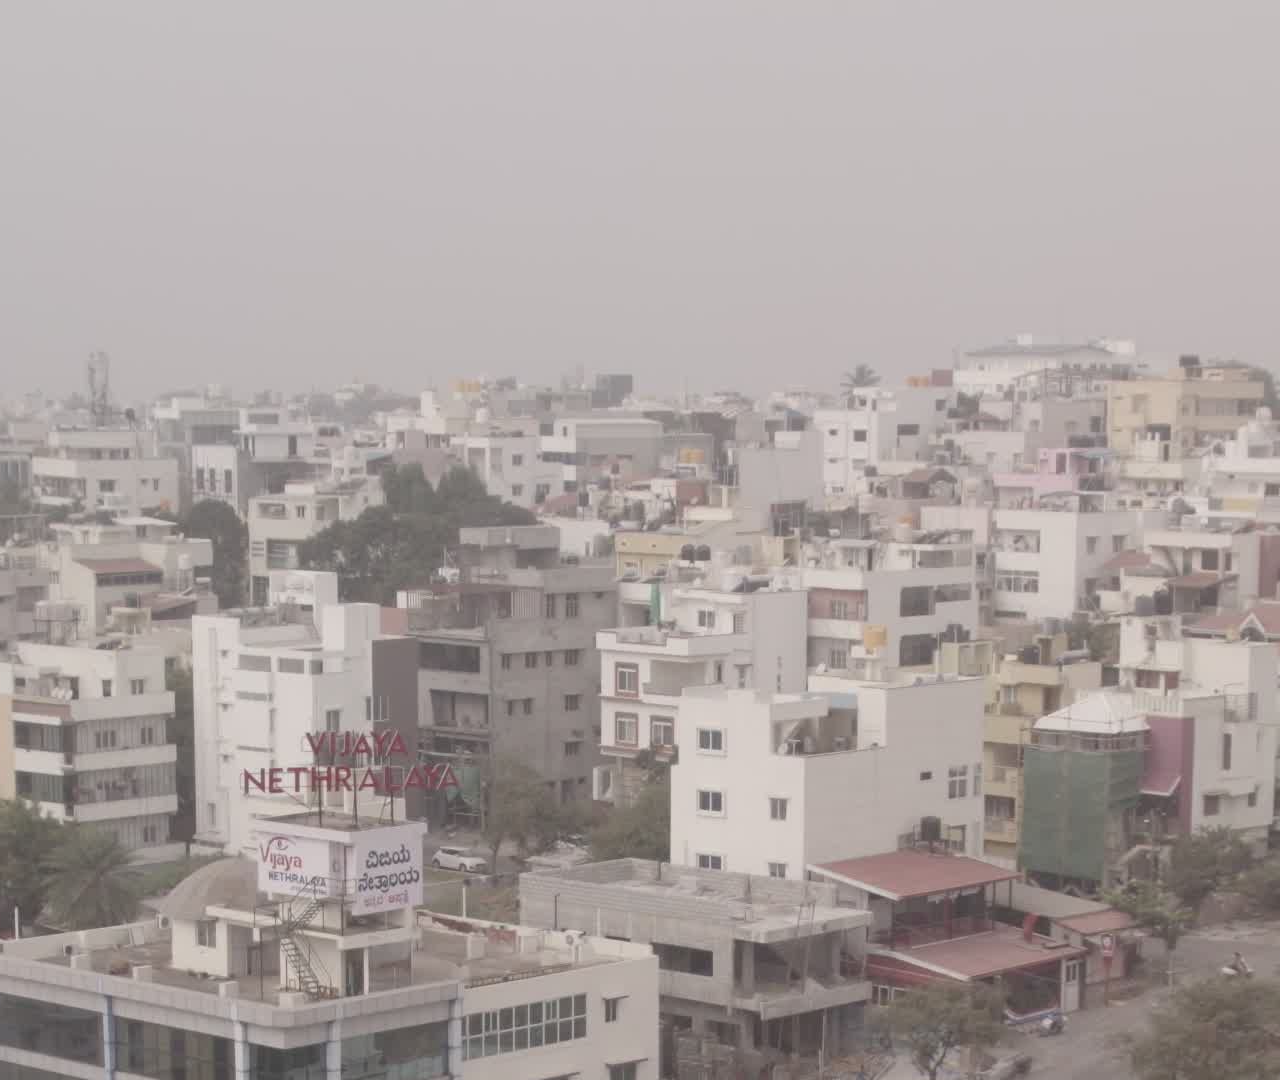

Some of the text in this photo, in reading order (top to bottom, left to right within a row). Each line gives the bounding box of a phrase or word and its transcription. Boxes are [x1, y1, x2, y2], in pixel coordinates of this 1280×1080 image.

[306, 730, 408, 757] VIJAYA
[243, 763, 460, 795] NETHRALAYA
[259, 836, 303, 871] Vijaya
[366, 844, 411, 868] ವಿಜಯ
[268, 871, 327, 887] NETHRALAYA
[358, 867, 420, 893] ನೇತ್ರಾಲಯ
